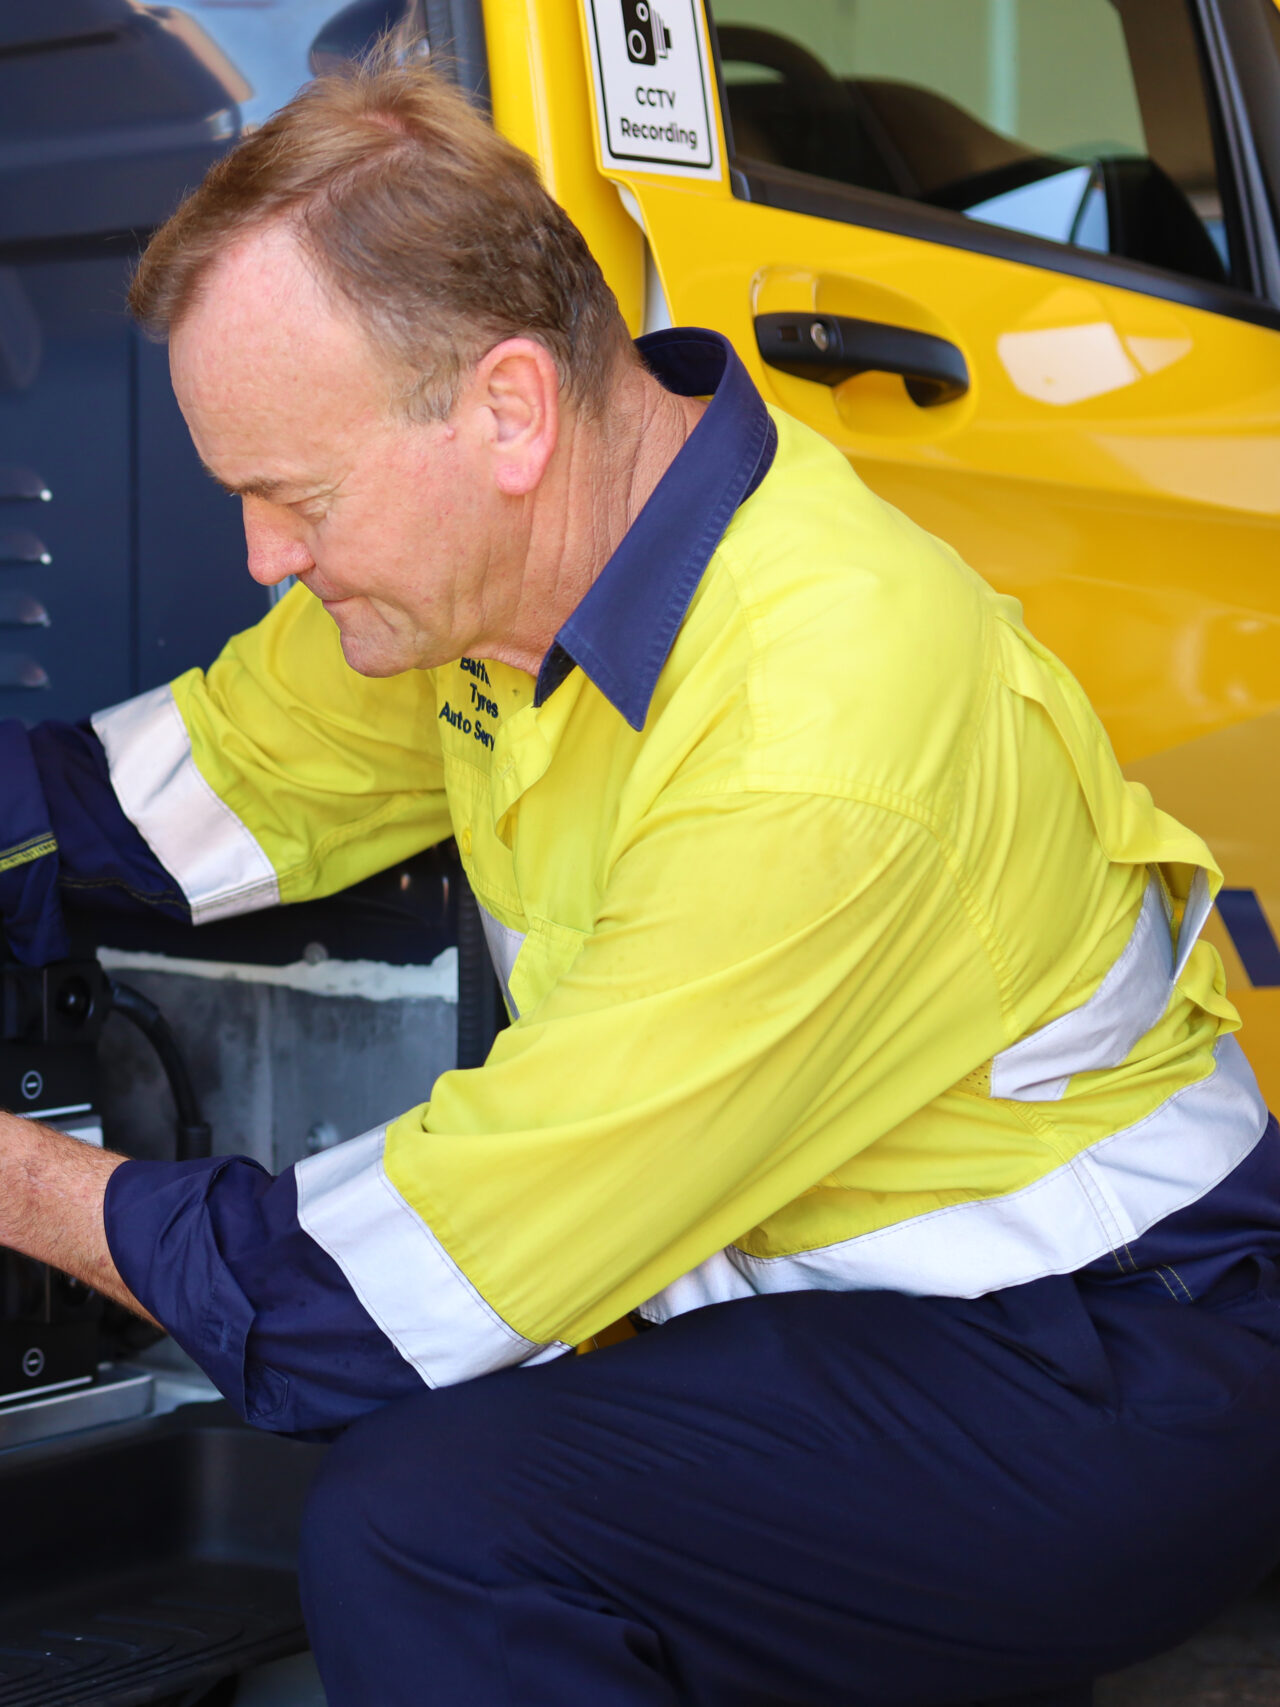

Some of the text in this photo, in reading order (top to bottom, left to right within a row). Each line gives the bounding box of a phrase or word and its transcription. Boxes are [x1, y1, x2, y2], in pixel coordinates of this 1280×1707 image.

[635, 85, 676, 109] CCTV
[620, 117, 698, 150] Recording
[469, 682, 499, 718] Tyres
[438, 701, 472, 734] Auto
